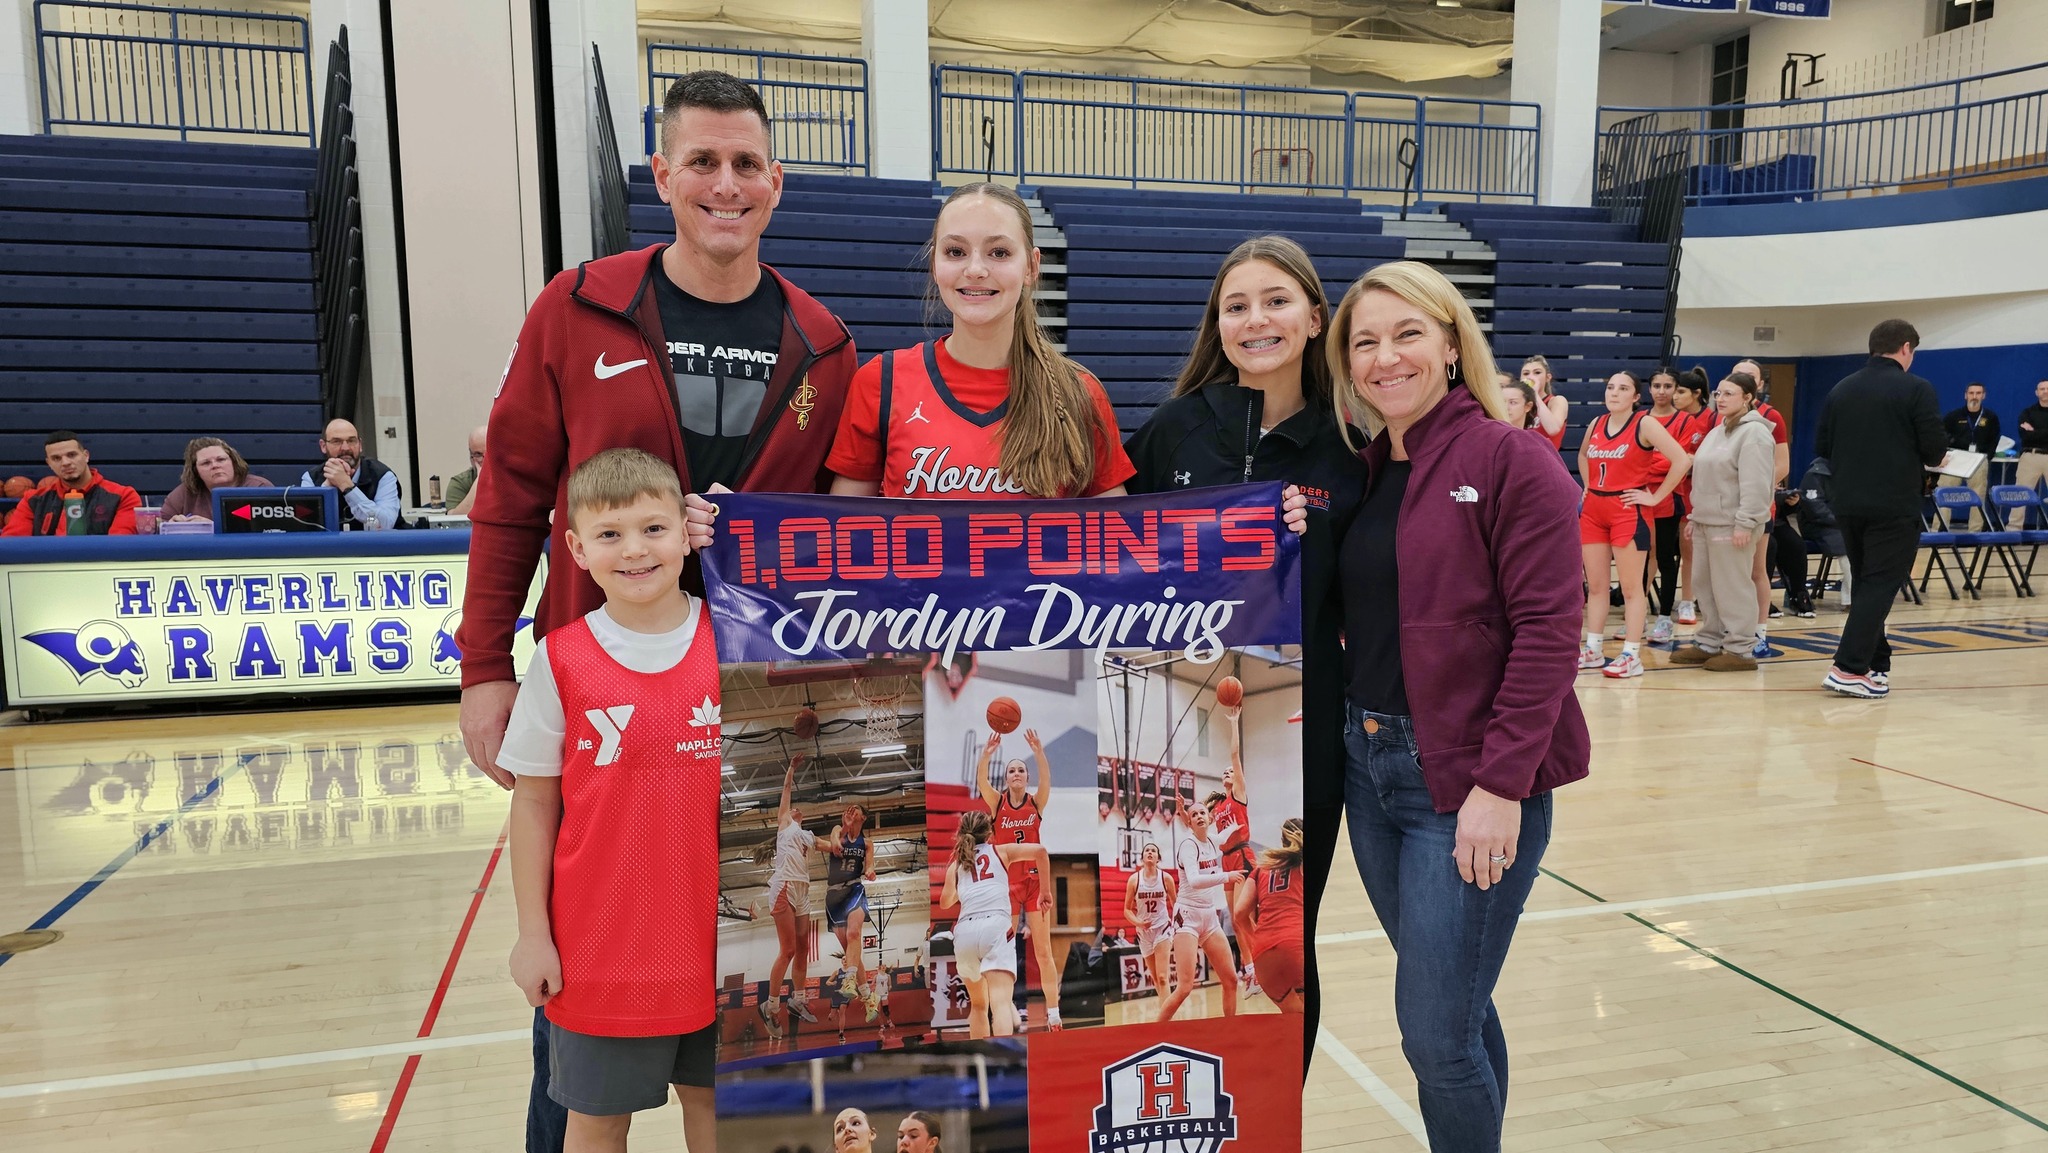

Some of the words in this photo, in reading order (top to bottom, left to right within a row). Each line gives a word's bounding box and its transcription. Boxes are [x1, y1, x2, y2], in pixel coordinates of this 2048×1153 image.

[1774, 1, 1805, 12] 1996
[711, 345, 779, 365] ARMO
[1586, 444, 1630, 459] Hornell
[67, 504, 83, 519] G
[251, 506, 295, 519] POSS
[729, 514, 944, 590] 1,000
[968, 506, 1276, 578] POINTS
[113, 569, 453, 618] HAVERLING
[771, 588, 1007, 671] Jordyn
[1009, 582, 1246, 667] Dyring
[163, 616, 414, 684] RAMS
[676, 738, 713, 752] MAPLE
[1001, 813, 1037, 829] Hornell
[1145, 900, 1157, 913] 12
[1136, 1060, 1191, 1121] H
[1099, 1121, 1227, 1146] BASKETBALL
